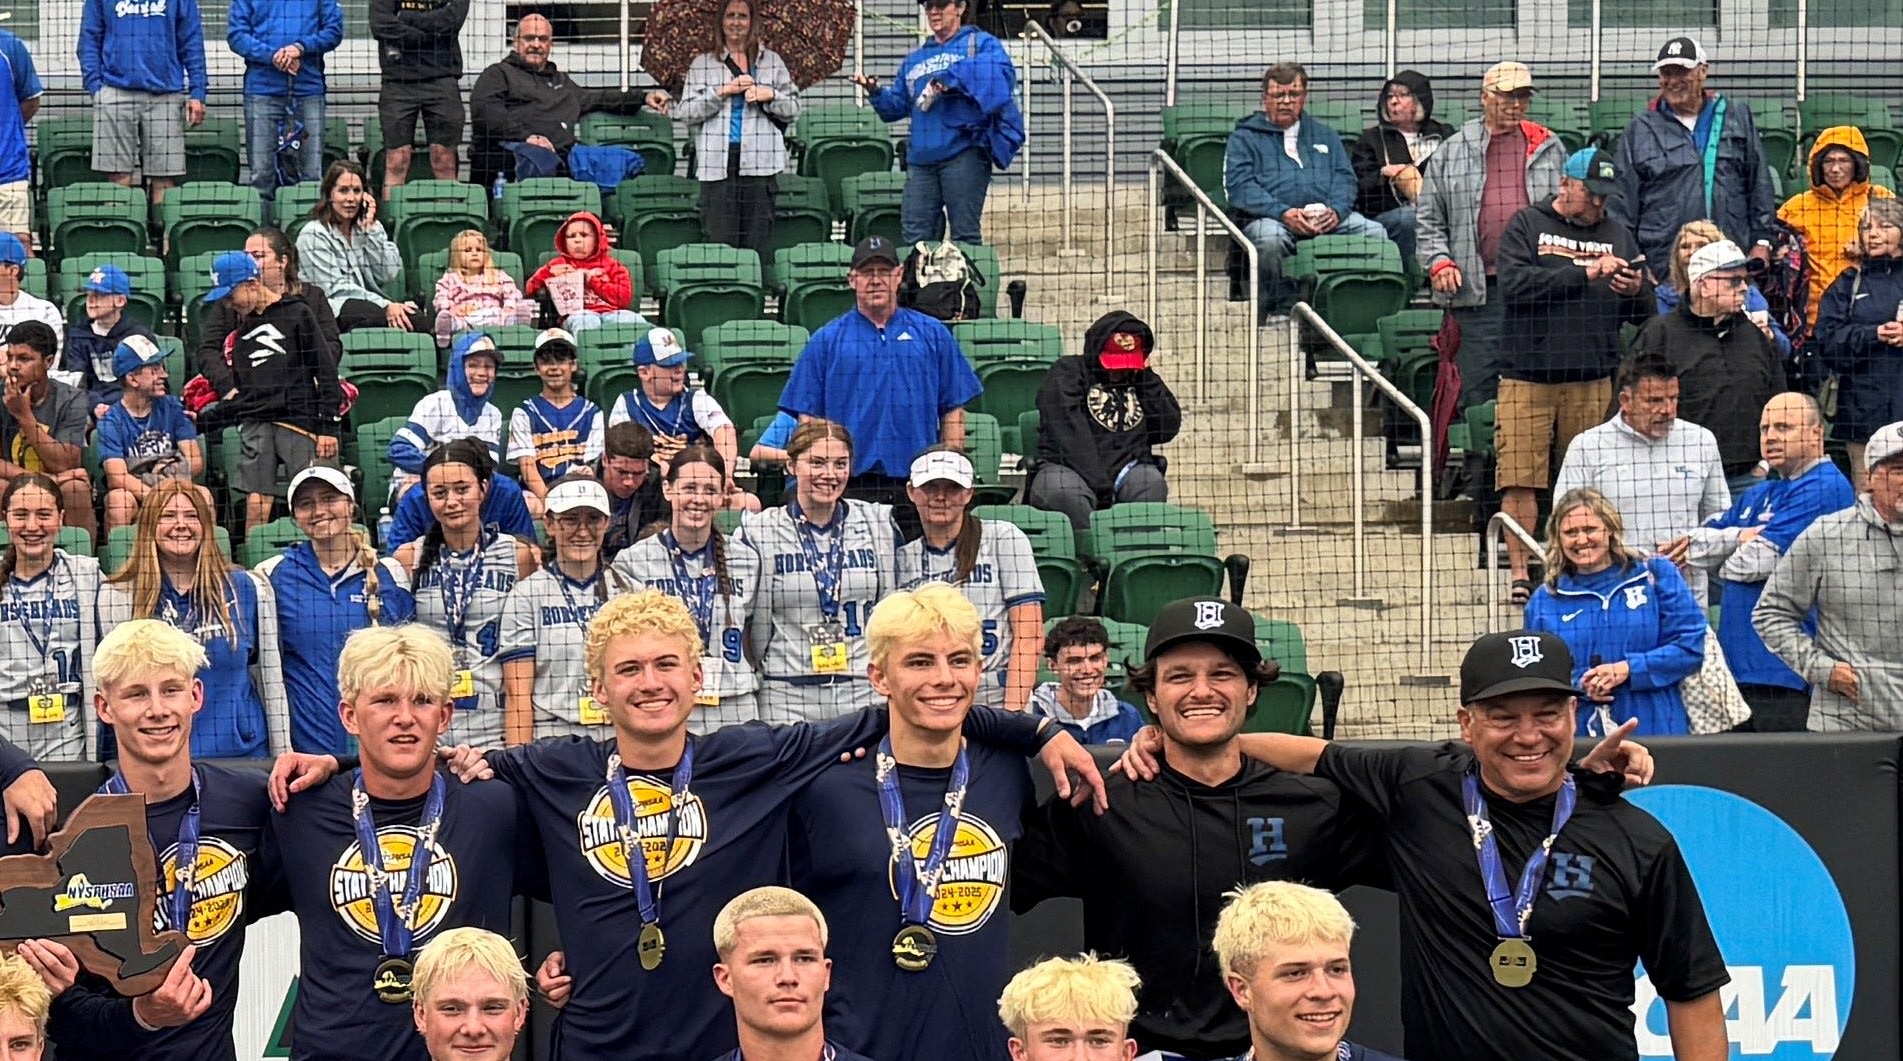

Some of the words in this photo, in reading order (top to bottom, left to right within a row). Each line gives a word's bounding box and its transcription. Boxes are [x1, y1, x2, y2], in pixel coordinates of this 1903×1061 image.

[0, 600, 78, 621] RSEHEADS
[1194, 601, 1225, 630] H
[477, 620, 501, 657] 4
[723, 627, 742, 663] 9
[1508, 636, 1544, 668] H
[583, 819, 617, 848] STAT
[1246, 818, 1288, 861] H
[337, 871, 368, 900] STAT
[1547, 852, 1595, 894] H
[936, 886, 982, 899] 024-2025
[1634, 964, 1841, 1056] CAA
